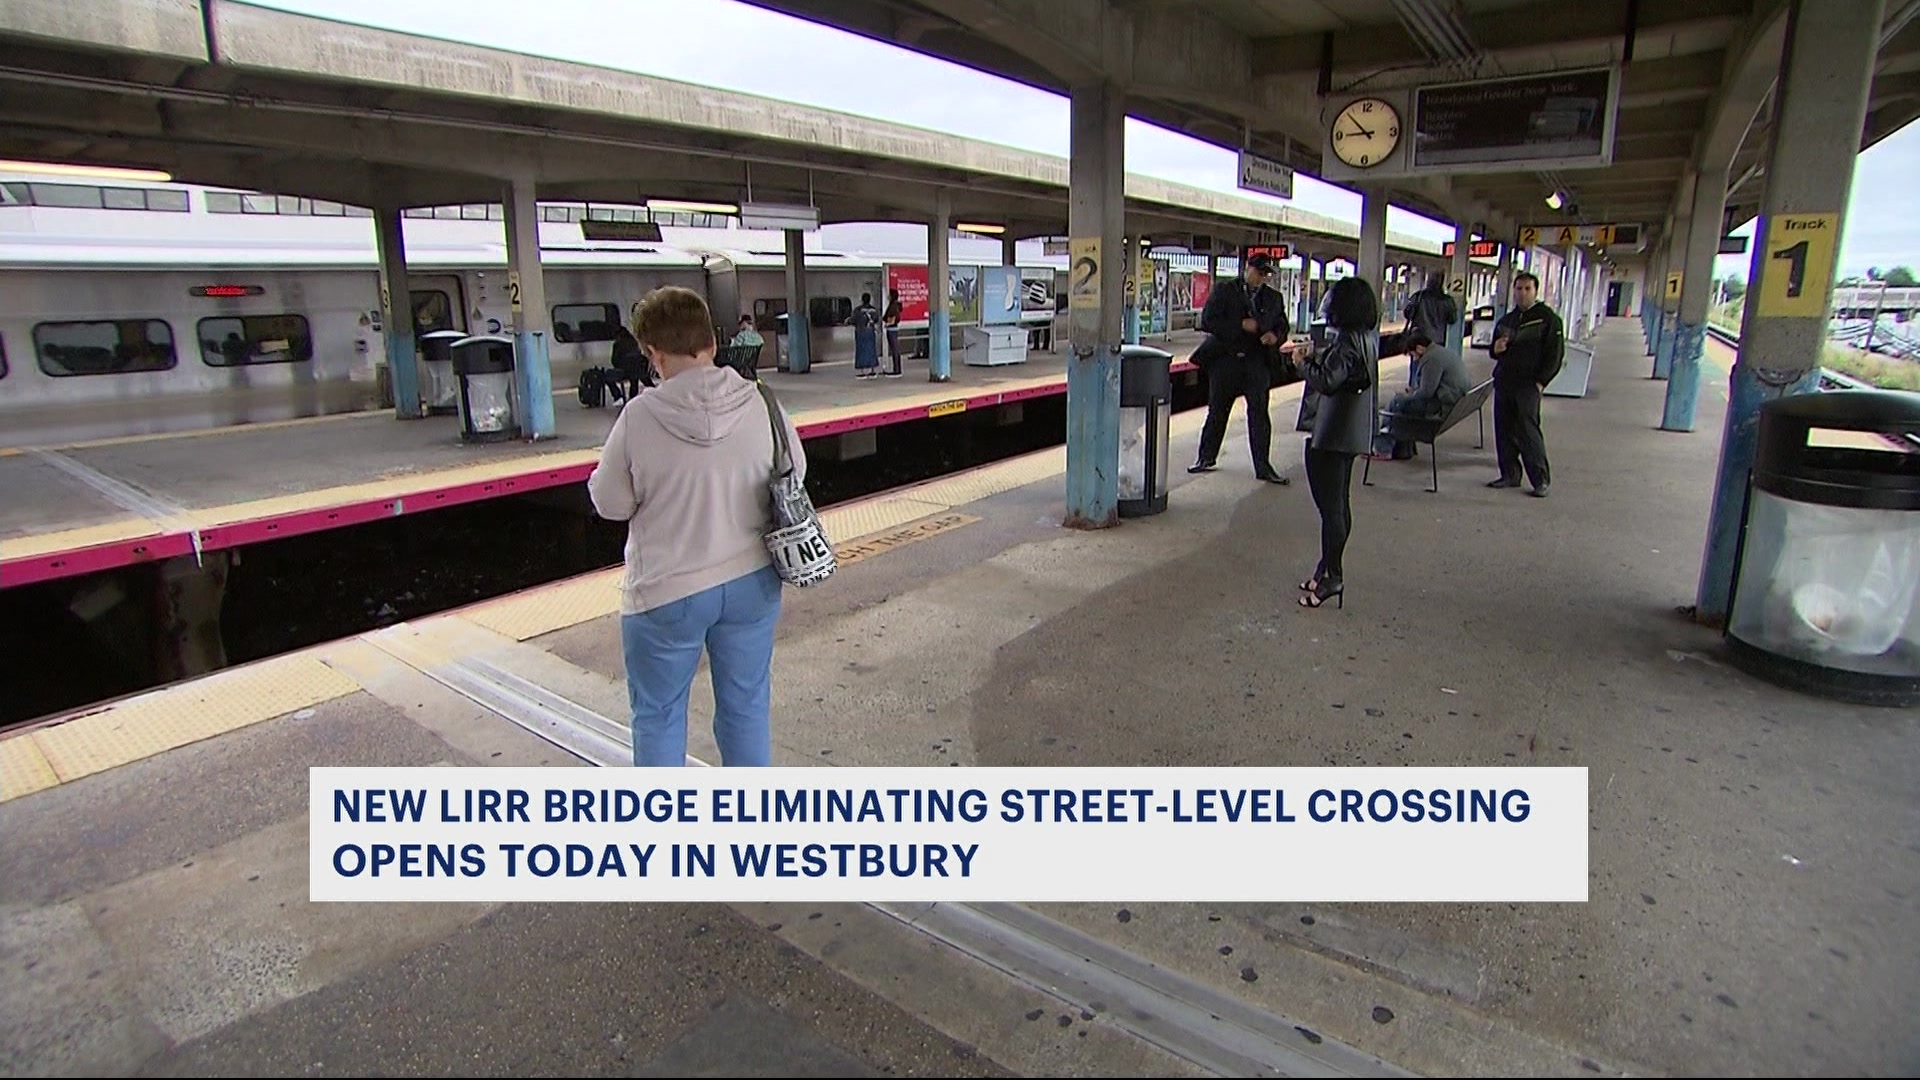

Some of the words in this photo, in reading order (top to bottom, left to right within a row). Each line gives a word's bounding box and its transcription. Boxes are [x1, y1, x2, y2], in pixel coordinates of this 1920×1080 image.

[1362, 102, 1373, 113] 12
[1335, 131, 1344, 141] 9
[1389, 126, 1398, 137] 3
[1360, 154, 1369, 165] 6
[1784, 218, 1827, 231] Track
[1523, 228, 1535, 242] 2
[1560, 227, 1573, 241] A
[1600, 227, 1609, 240] 1
[1773, 241, 1810, 298] 1
[1073, 256, 1098, 297] 2
[1126, 280, 1134, 292] 2
[1453, 279, 1463, 292] 2
[1669, 278, 1678, 293] 1
[510, 282, 520, 305] 2
[868, 529, 924, 547] THE
